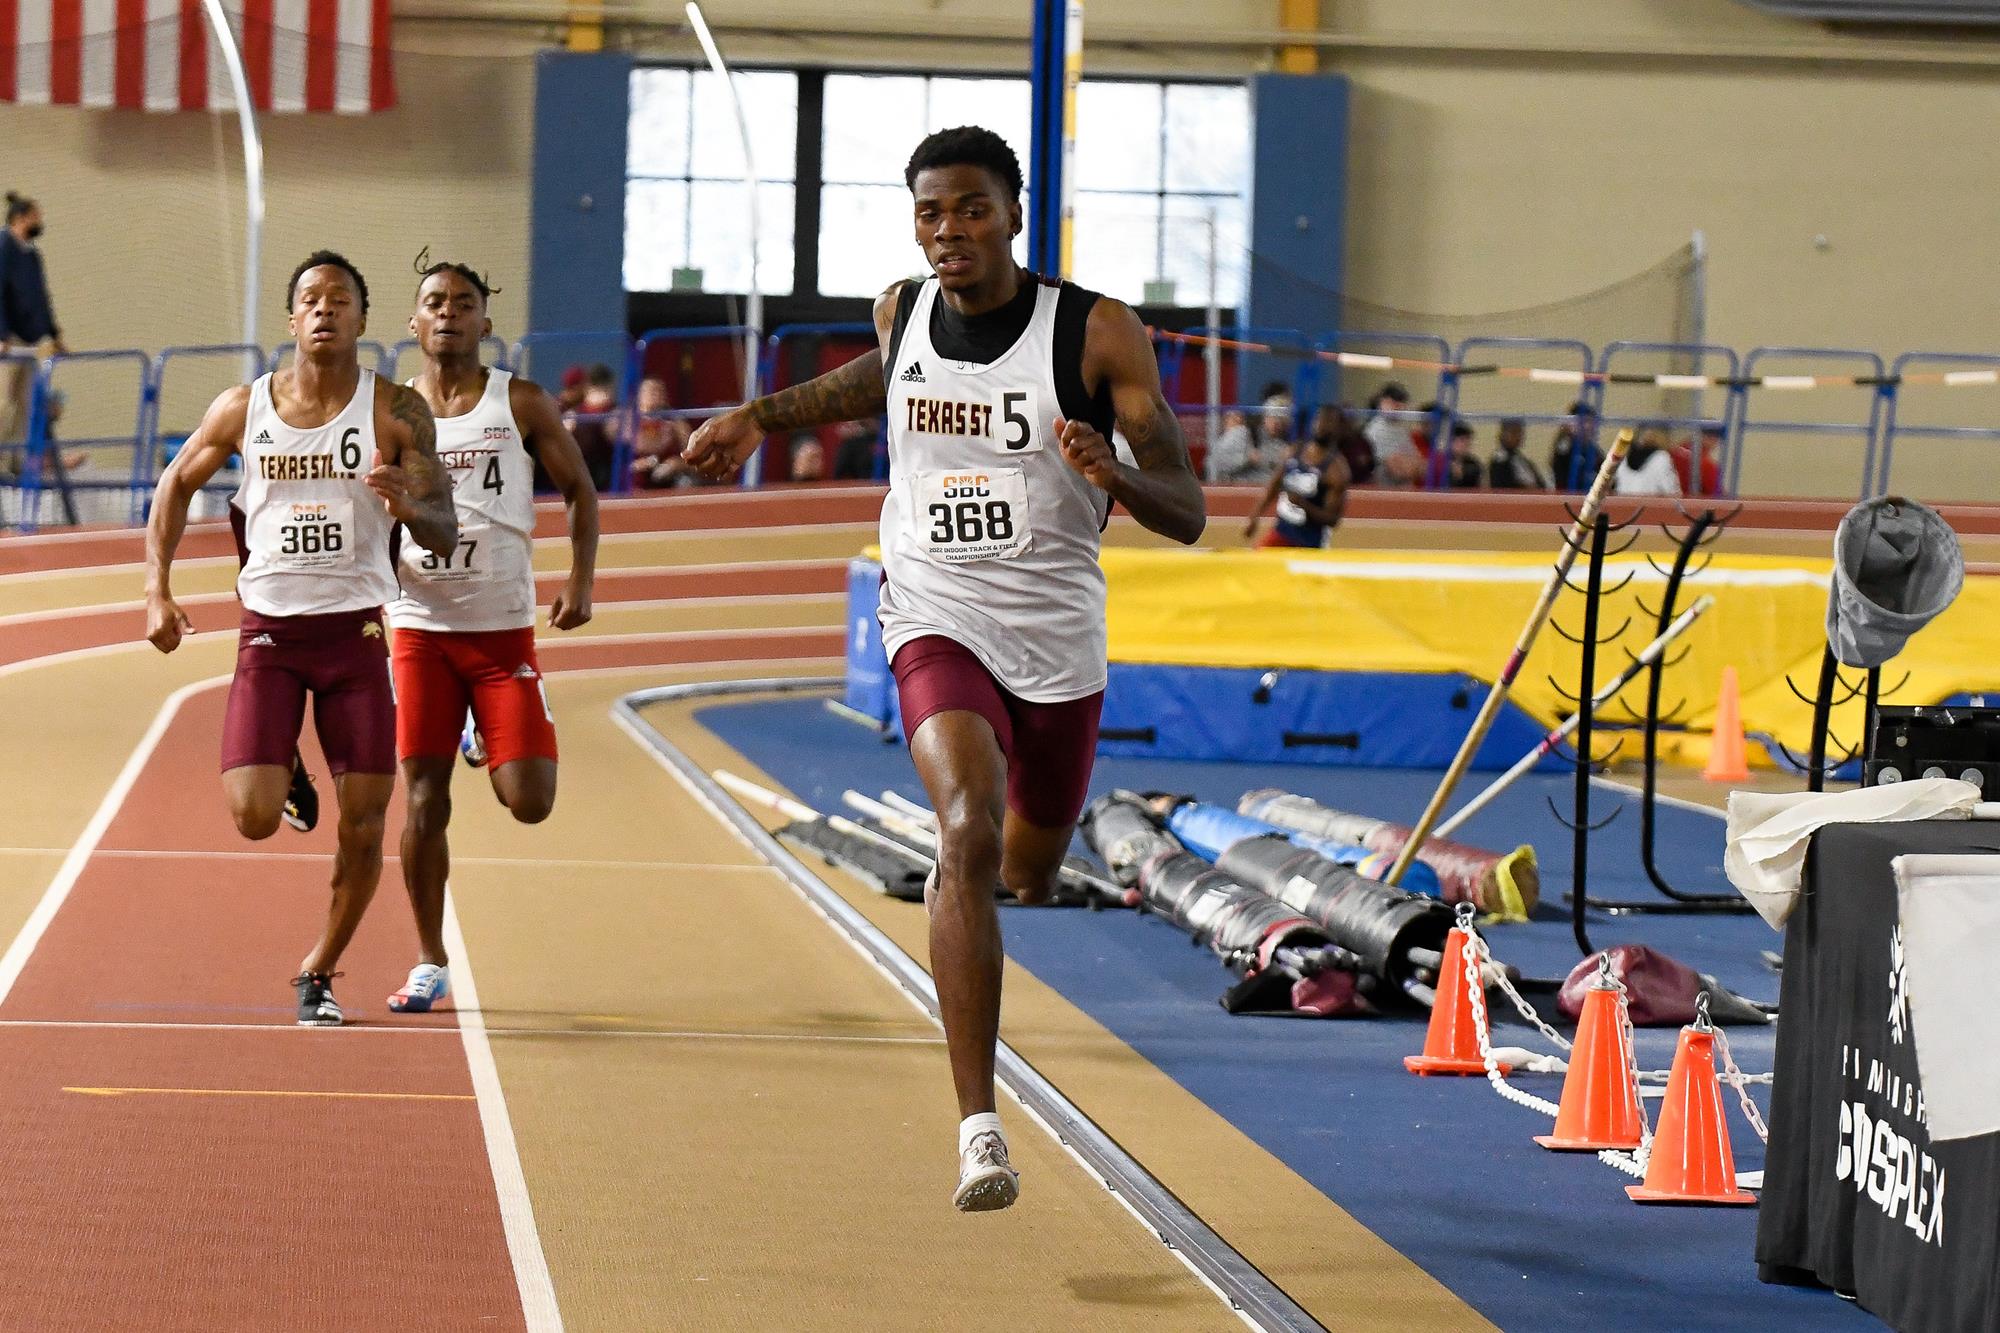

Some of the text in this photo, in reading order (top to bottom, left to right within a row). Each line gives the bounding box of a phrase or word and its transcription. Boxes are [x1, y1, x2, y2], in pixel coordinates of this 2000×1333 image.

[900, 374, 926, 384] adidas
[907, 397, 995, 437] TEXAS ST
[1003, 392, 1031, 450] 5
[483, 427, 511, 440] SBC
[341, 427, 361, 470] 6
[260, 455, 308, 480] TEXAS
[483, 455, 504, 496] 4
[943, 475, 990, 499] SBC
[928, 500, 1014, 543] 368
[281, 523, 343, 554] 366
[998, 542, 1019, 550] FIELD
[945, 552, 1000, 561] CHAMPIONSHIPS
